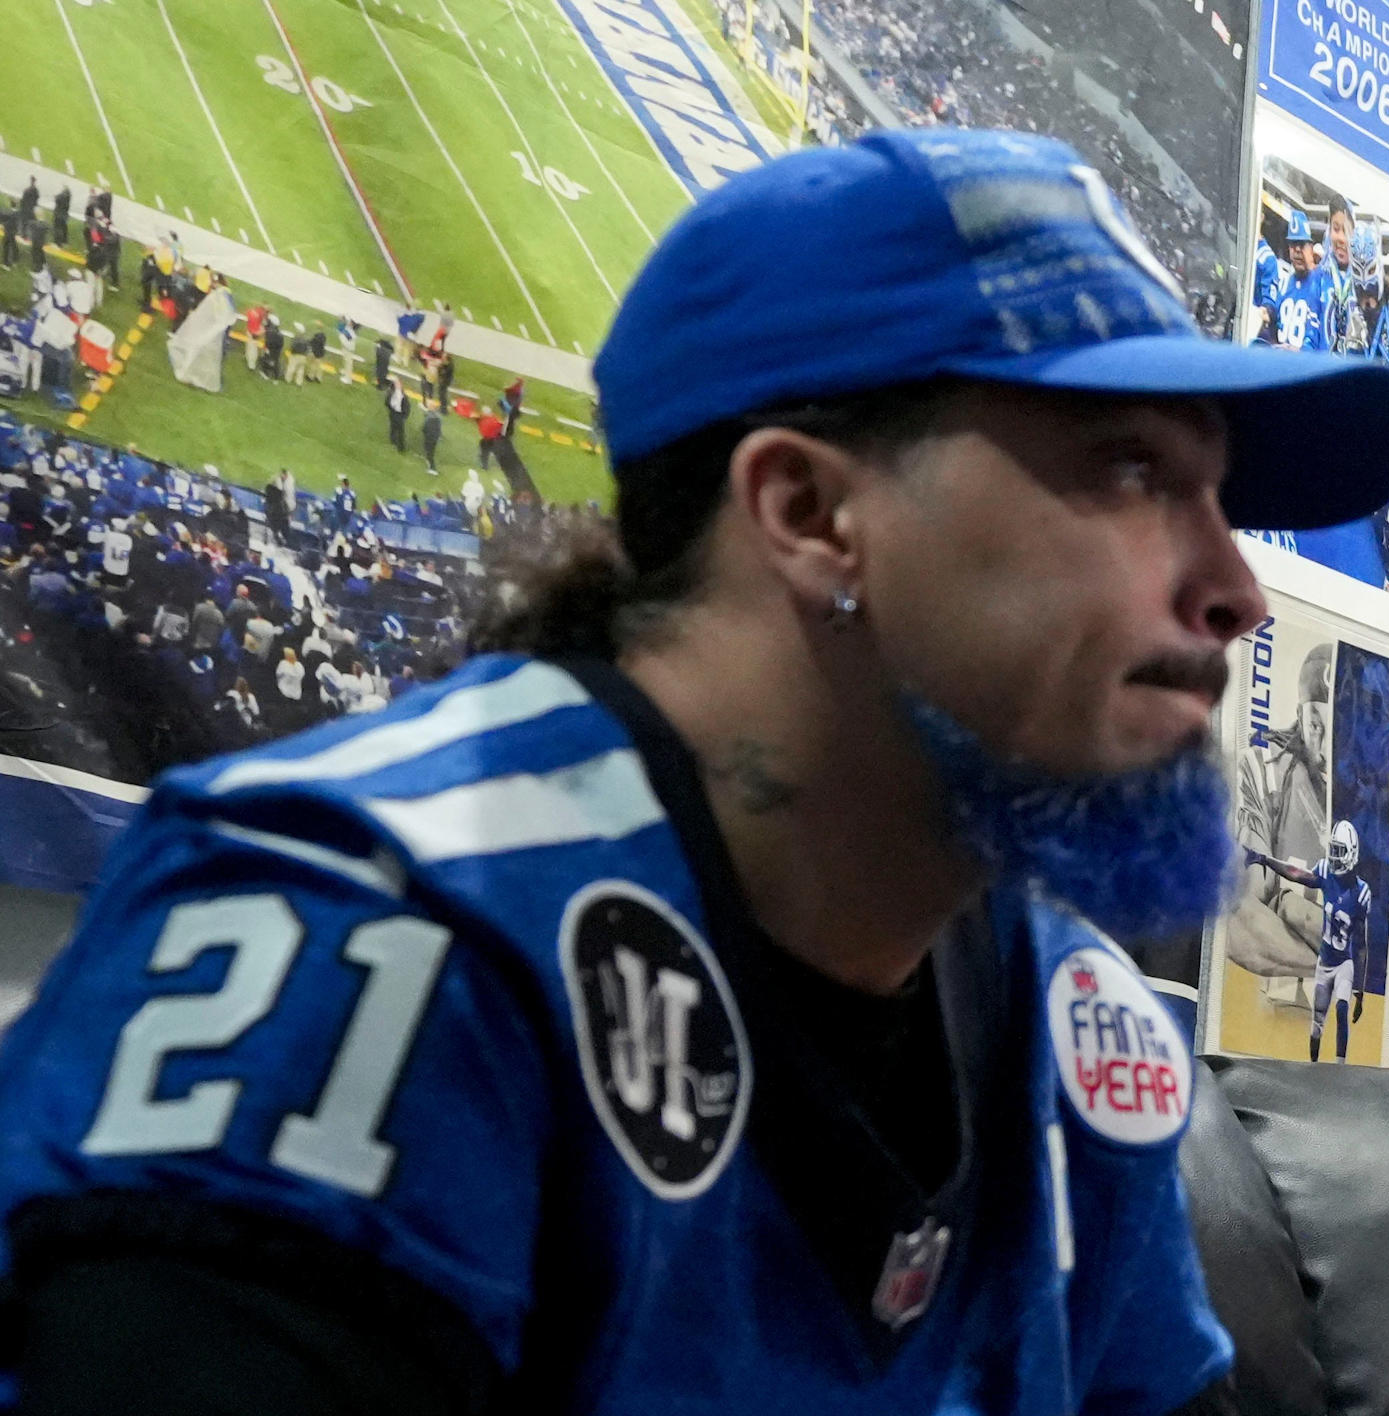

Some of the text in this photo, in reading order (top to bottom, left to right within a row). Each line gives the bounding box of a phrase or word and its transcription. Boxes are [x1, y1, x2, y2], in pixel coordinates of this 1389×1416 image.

[1249, 616, 1276, 750] HILTON
[79, 893, 454, 1198] 21
[1070, 1000, 1146, 1057] FAN
[1076, 1056, 1185, 1118] YEAR
